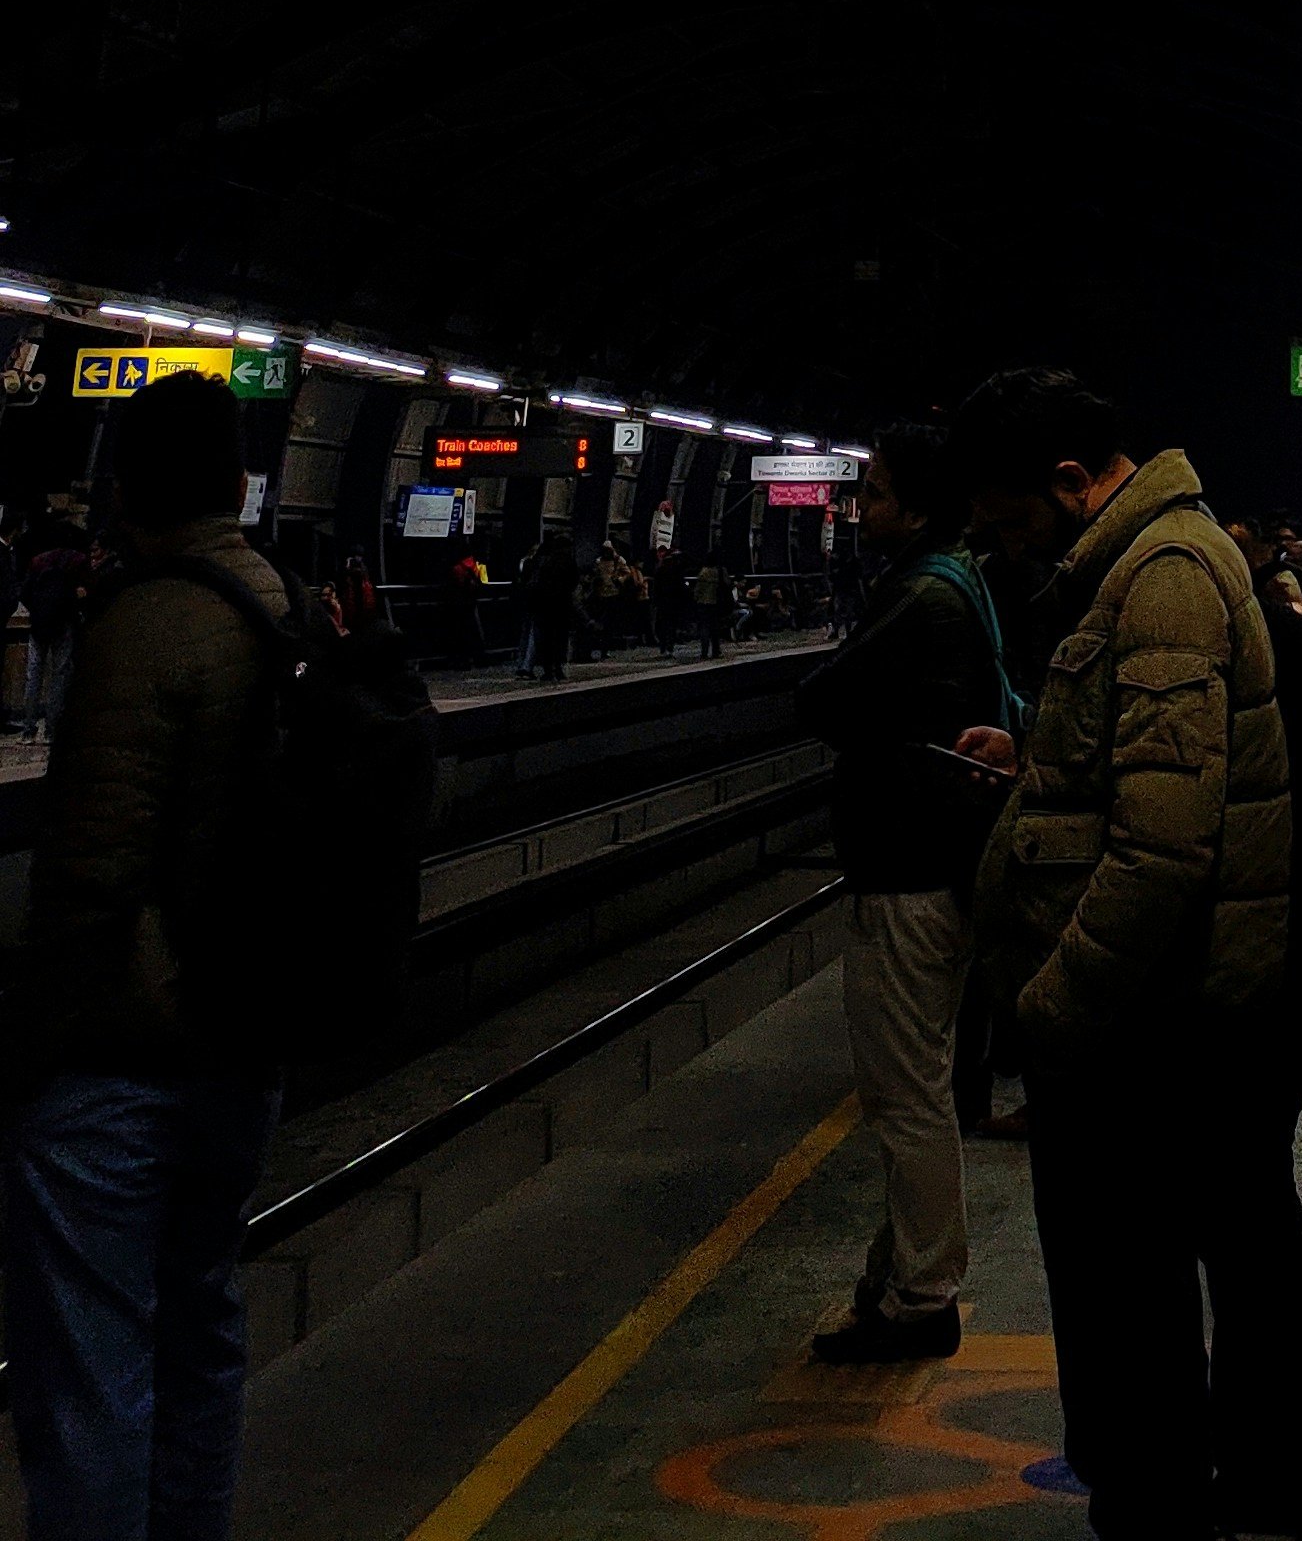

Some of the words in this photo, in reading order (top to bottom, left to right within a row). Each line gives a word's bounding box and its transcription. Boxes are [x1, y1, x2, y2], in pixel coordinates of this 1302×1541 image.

[437, 439, 465, 452] Train
[468, 439, 518, 452] Coaches
[622, 429, 635, 447] 2
[841, 461, 851, 476] 2
